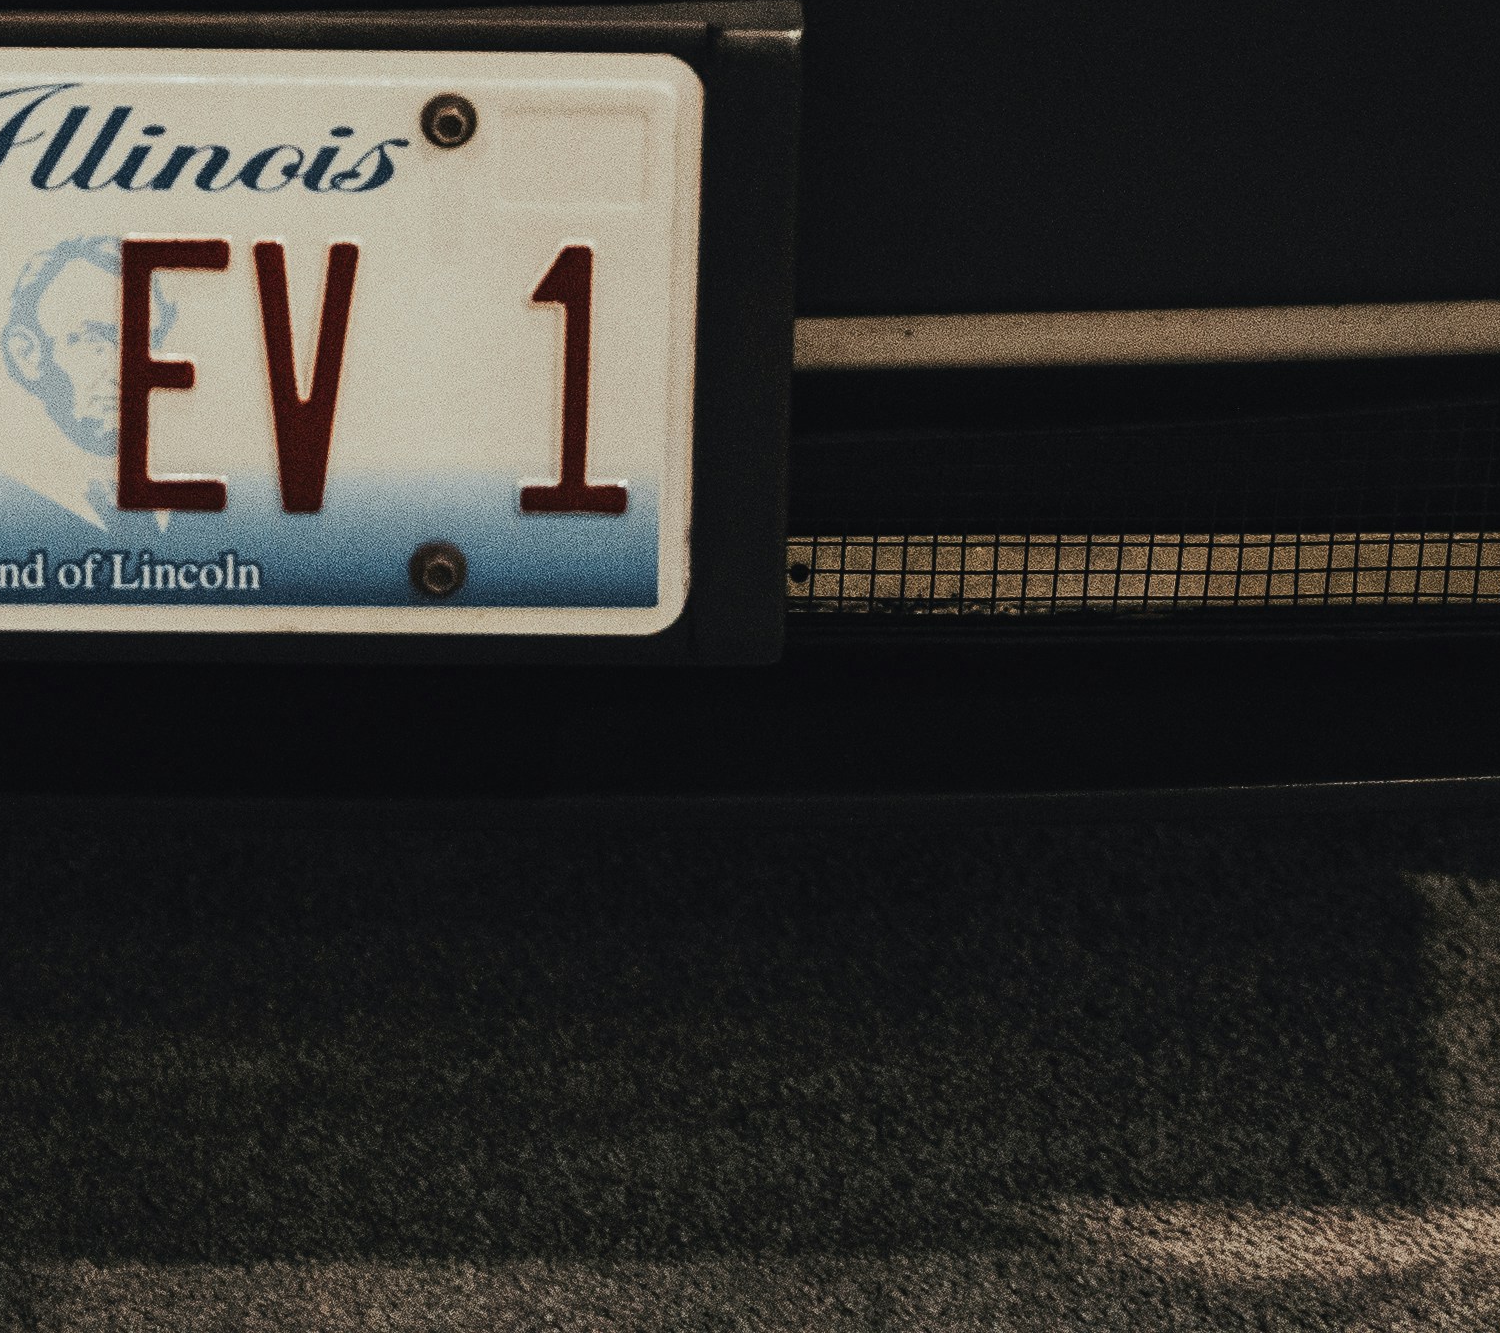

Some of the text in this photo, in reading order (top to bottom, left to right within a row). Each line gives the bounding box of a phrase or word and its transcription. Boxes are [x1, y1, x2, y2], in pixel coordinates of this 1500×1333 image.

[116, 238, 361, 513] EV
[518, 243, 629, 515] 1
[57, 551, 101, 590] of
[110, 551, 261, 591] Lincoln
